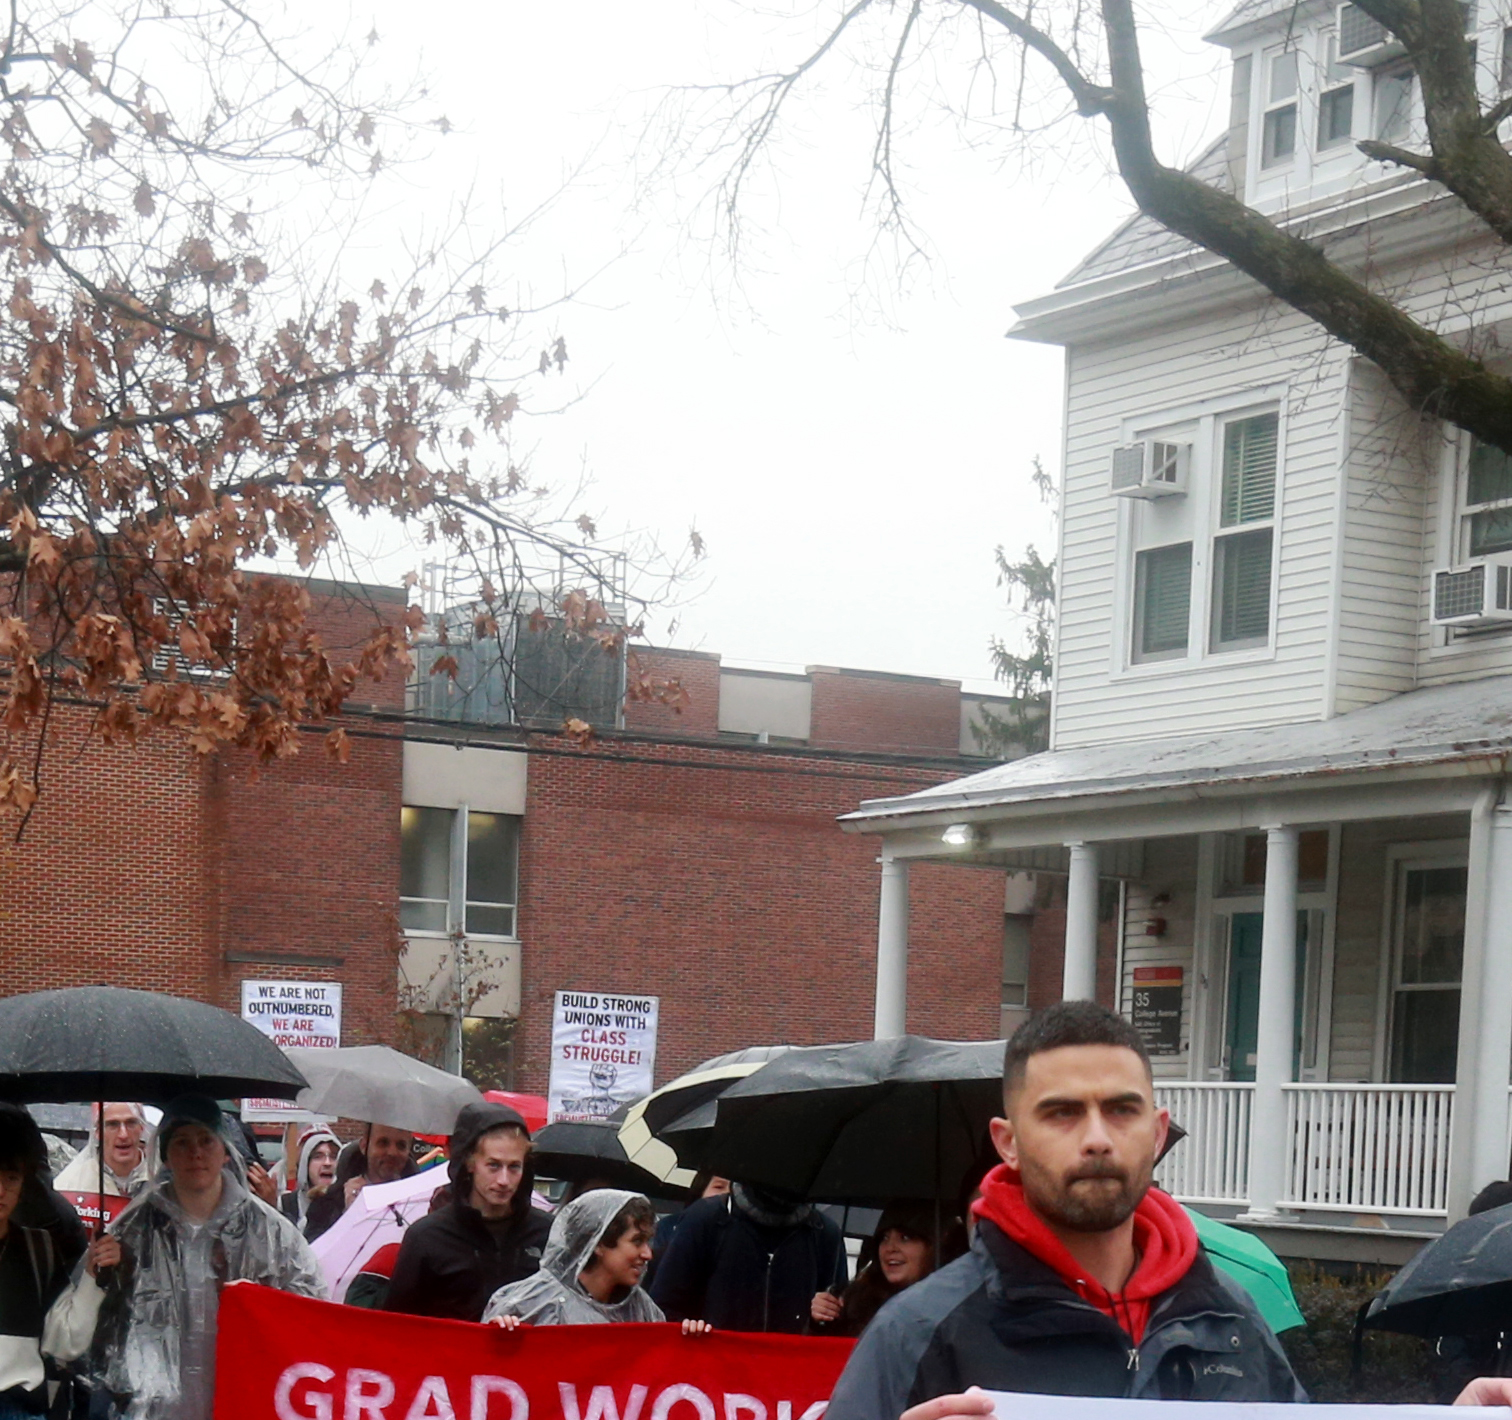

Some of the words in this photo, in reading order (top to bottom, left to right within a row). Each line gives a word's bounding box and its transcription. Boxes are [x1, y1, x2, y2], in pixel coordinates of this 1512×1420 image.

[259, 986, 276, 998] WE
[279, 987, 302, 999] ARE
[305, 988, 326, 1000] NOT
[1135, 993, 1150, 1007] 35
[249, 1003, 334, 1018] OUTNUMBERED,
[562, 994, 598, 1009] BUILD
[602, 998, 651, 1013] STRONG
[273, 1019, 289, 1030] WE
[293, 1020, 314, 1031] ARE
[565, 1011, 611, 1027] UNIONS
[615, 1014, 646, 1030] WITH
[581, 1029, 627, 1045] CLASS
[563, 1045, 641, 1065] STRUGGLE!
